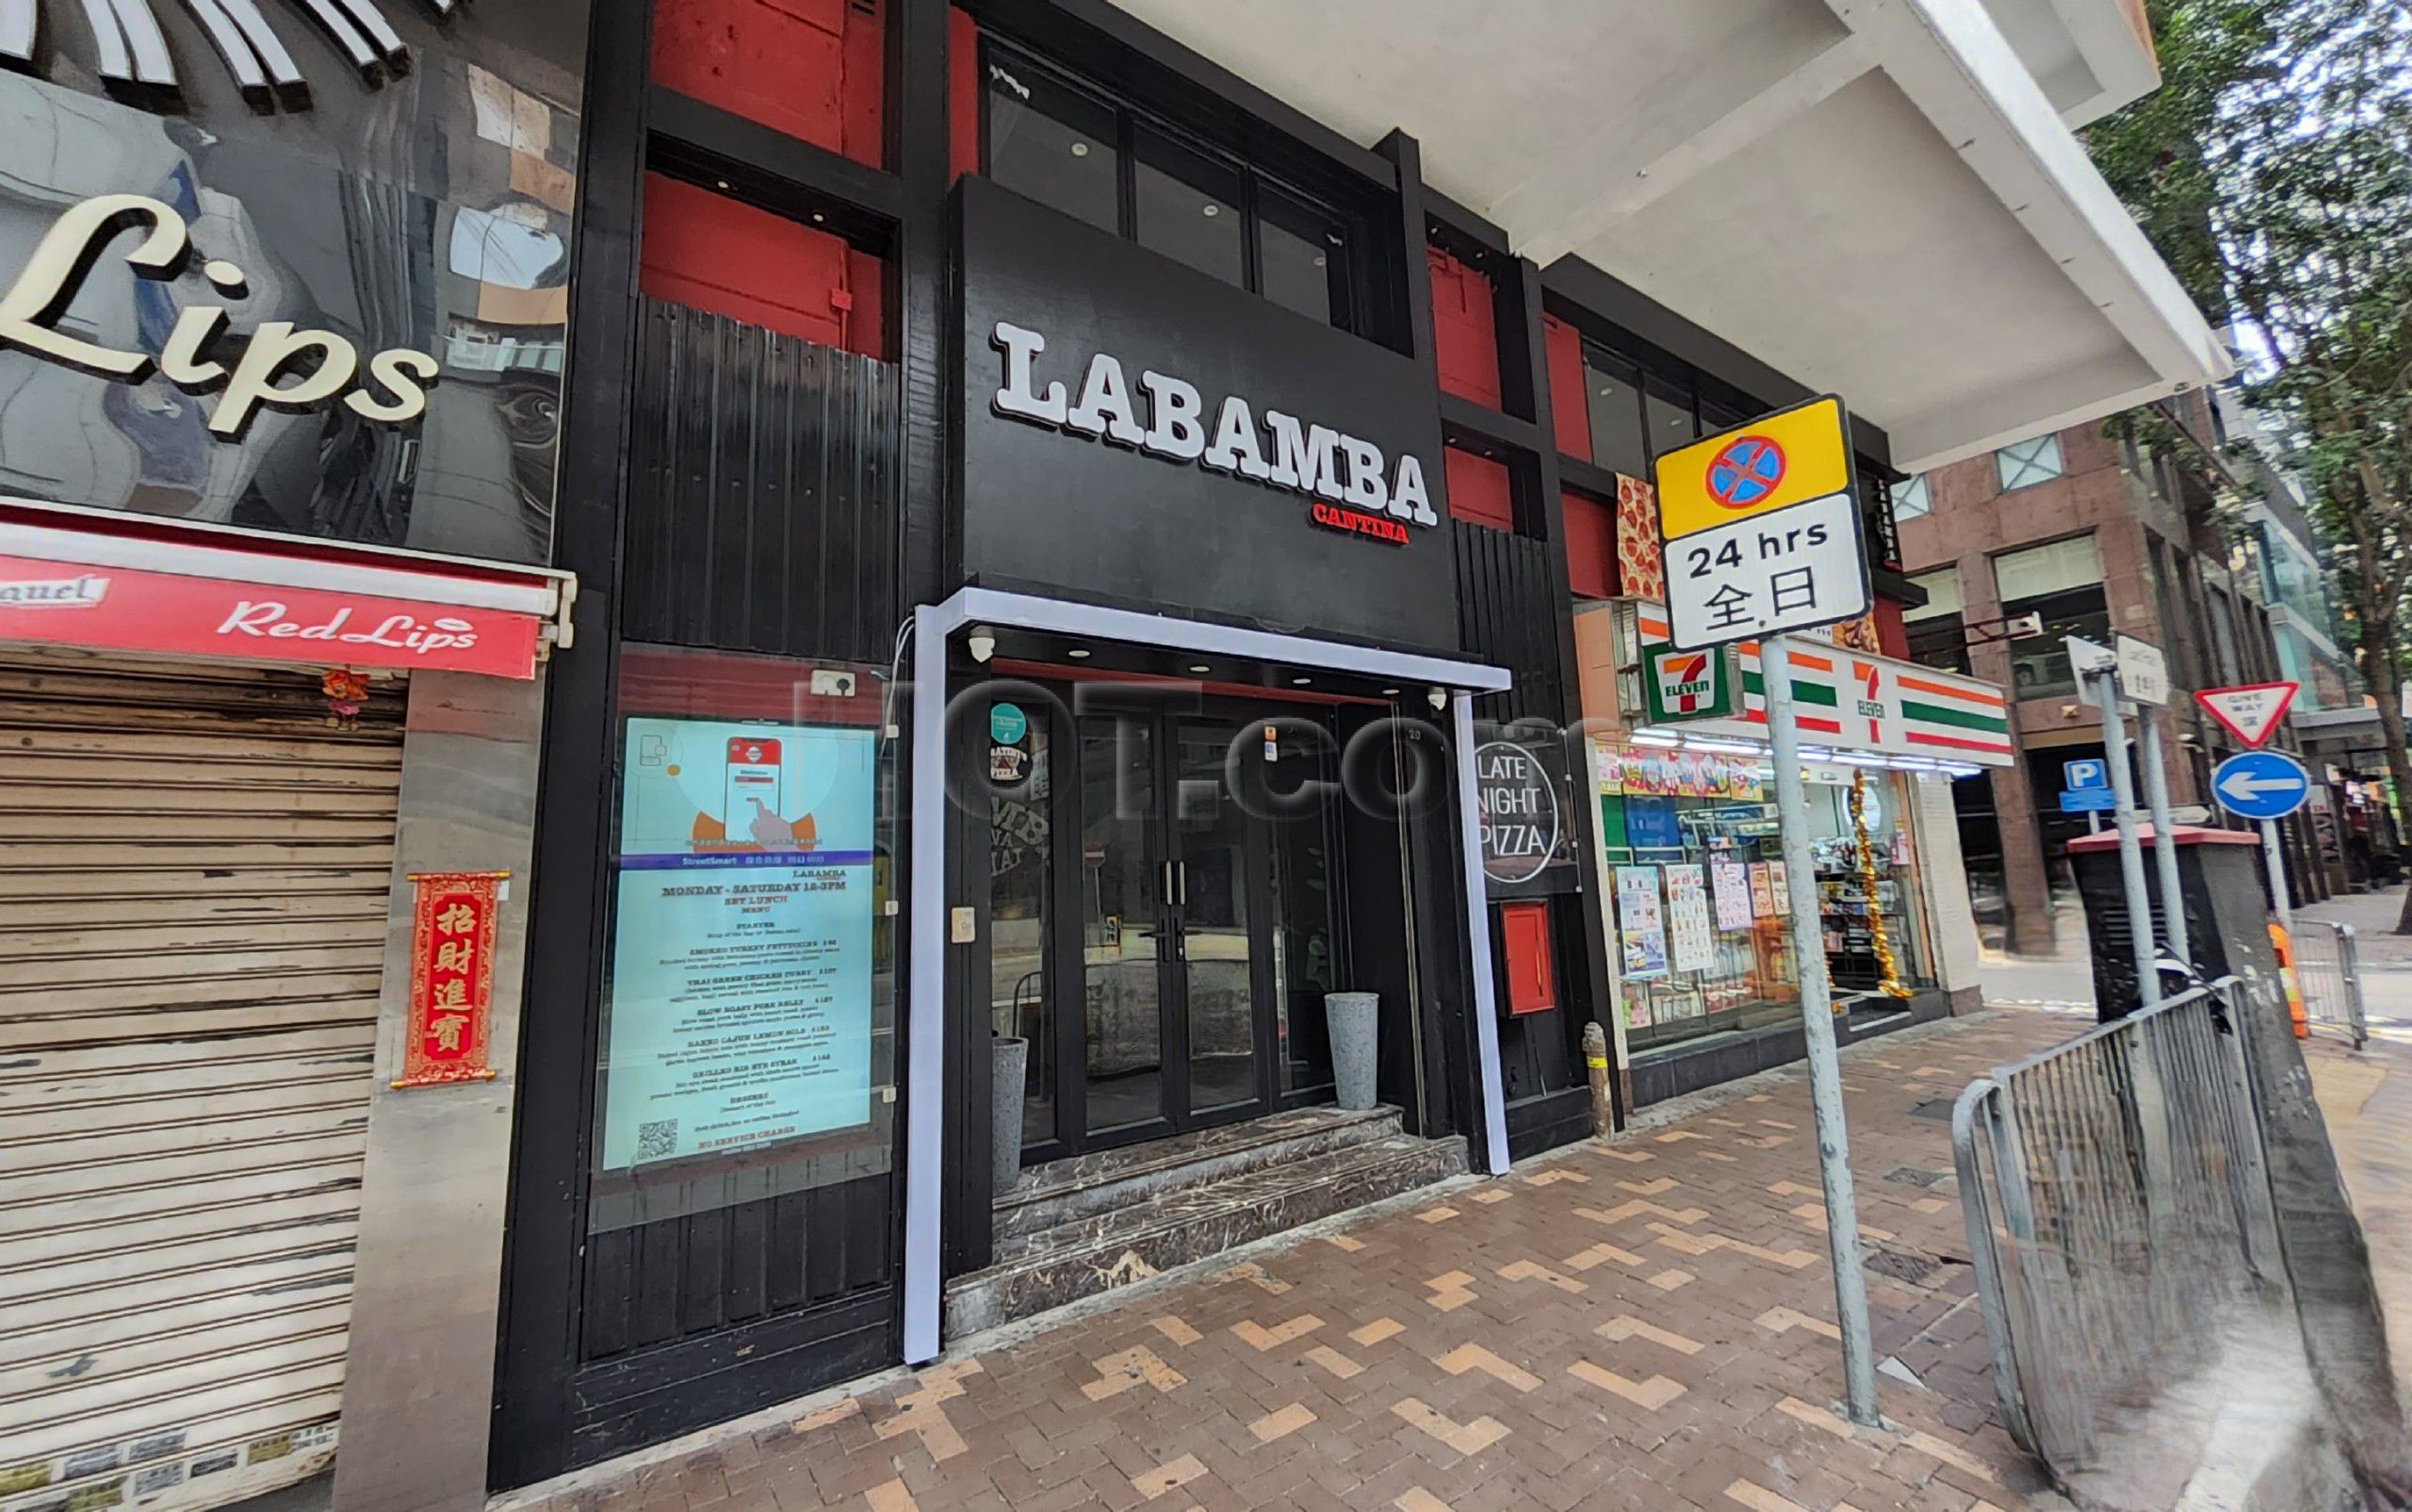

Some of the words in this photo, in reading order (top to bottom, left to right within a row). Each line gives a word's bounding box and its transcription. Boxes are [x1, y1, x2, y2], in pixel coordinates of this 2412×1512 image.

[0, 194, 440, 436] Lips
[992, 321, 1437, 528] LABAMBA
[1312, 503, 1410, 545] CANTINA
[1687, 538, 1743, 578] 24
[1758, 523, 1828, 560] hrs
[1703, 565, 1817, 630] 全日
[217, 601, 351, 640] Red
[340, 615, 479, 654] Lips
[1663, 654, 1706, 713] 7
[2227, 692, 2263, 704] GIVE
[1852, 660, 1881, 744] 7
[2231, 702, 2263, 712] WAY
[1477, 755, 1527, 780] LATE
[2072, 763, 2098, 787] P
[1478, 787, 1541, 815] NIGHT
[1480, 825, 1547, 856] PIZZA
[661, 886, 724, 897] MONDAY
[732, 883, 801, 894] SATURDAY
[725, 897, 746, 905] SET
[748, 895, 788, 904] LUNCH
